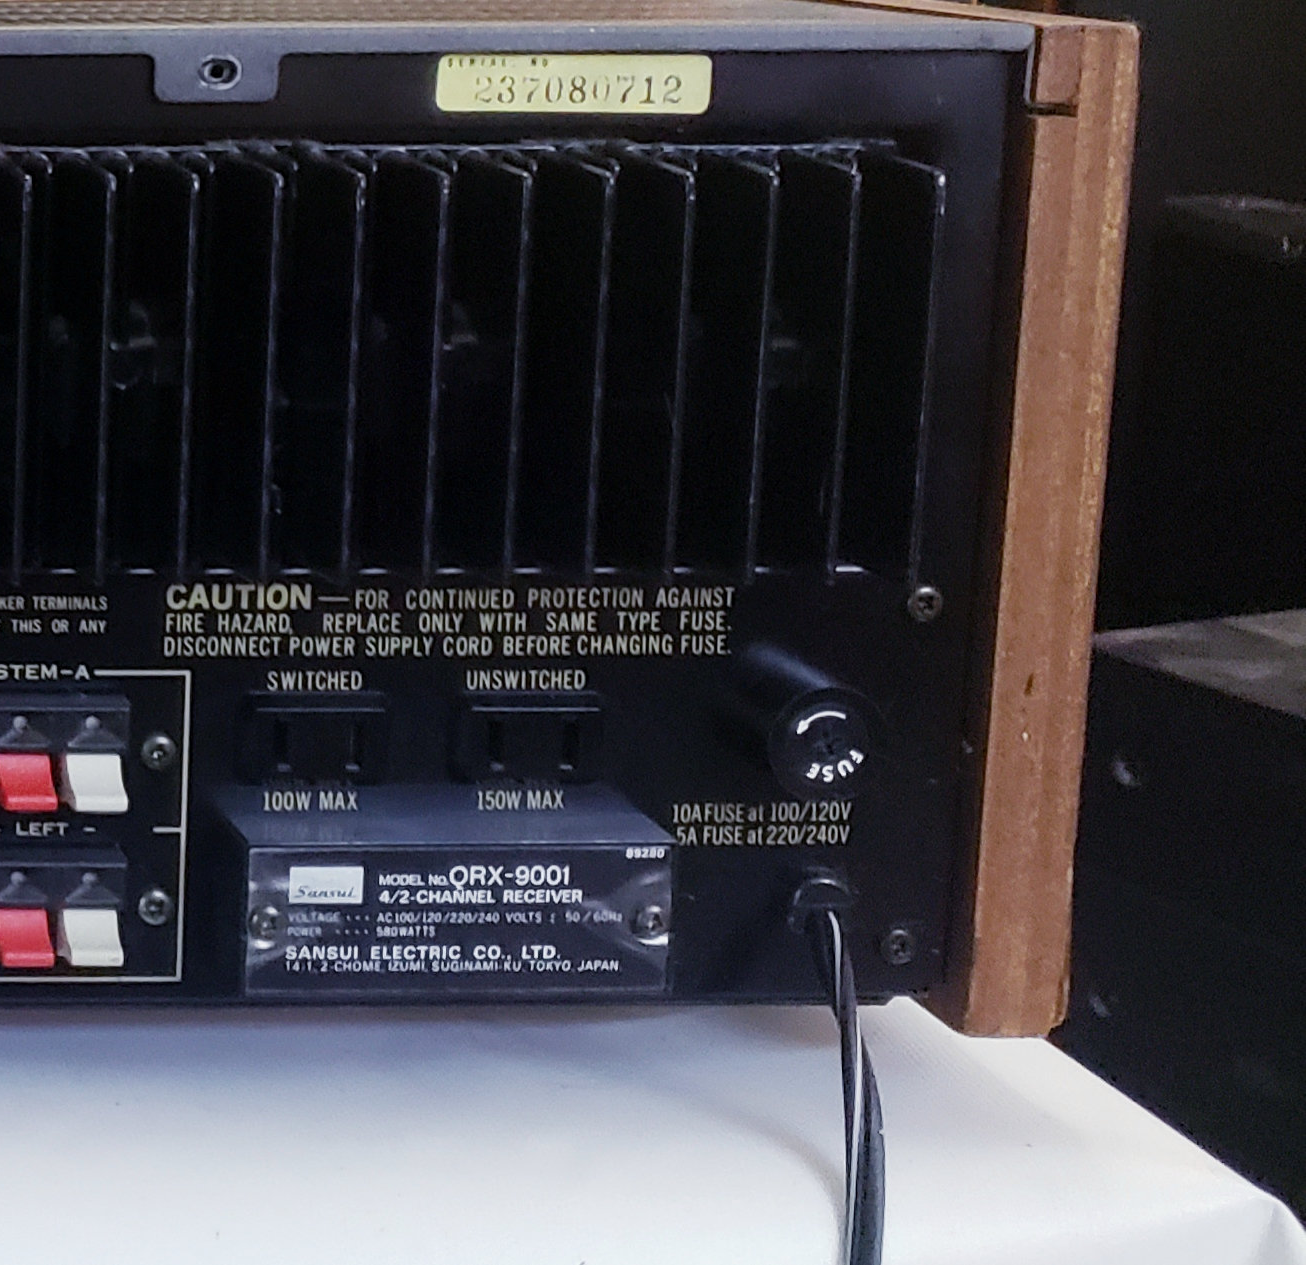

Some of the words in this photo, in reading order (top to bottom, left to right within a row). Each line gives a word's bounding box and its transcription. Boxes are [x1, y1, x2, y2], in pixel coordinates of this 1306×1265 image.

[473, 75, 682, 105] 237080712
[33, 595, 108, 611] TERMINALS
[166, 584, 312, 611] CAUTION
[354, 590, 389, 610] FOR
[406, 589, 514, 610] CONTINUED
[528, 588, 643, 609] PROTECTION
[655, 587, 735, 608] AGAINST
[12, 618, 43, 634] THIS
[79, 618, 107, 634] ANY
[165, 613, 204, 633] FIRE
[323, 613, 402, 633] REPLACE
[419, 613, 463, 633] ONLY
[478, 612, 527, 632] WITH
[546, 612, 596, 632] SAME
[616, 611, 661, 631] TYPE
[679, 611, 732, 631] FUSE.
[163, 636, 280, 657] DISCONNECT
[289, 636, 355, 657] POWER
[364, 636, 434, 657] SUPPLY
[443, 635, 493, 656] CORD
[503, 635, 571, 656] BEFORE
[577, 635, 673, 656] CHANGING
[680, 634, 733, 655] FUSE.
[267, 670, 363, 691] SWITCHED
[466, 669, 586, 691] UNSWITCHED
[806, 750, 864, 783] FUSE
[262, 791, 310, 812] 100W
[318, 791, 358, 812] MAX
[476, 790, 523, 811] 150W
[526, 790, 564, 811] MAX
[747, 802, 764, 822] at
[770, 801, 852, 822] 100/120V
[15, 821, 70, 837] LEFT
[677, 826, 698, 846] 5A
[703, 826, 745, 845] FUSE
[746, 825, 763, 845] at
[766, 825, 850, 845] 220/240V
[379, 874, 426, 887] MODEL
[449, 865, 570, 890] QRX-9001
[294, 885, 357, 900] Sansui
[379, 889, 496, 905] 4/2-CHANNEL
[503, 889, 583, 904] RECEIVER
[285, 945, 359, 960] SANSUI
[370, 945, 461, 960] ELECTRIC
[521, 944, 561, 960] LTD.
[577, 960, 619, 972] JAPAN
